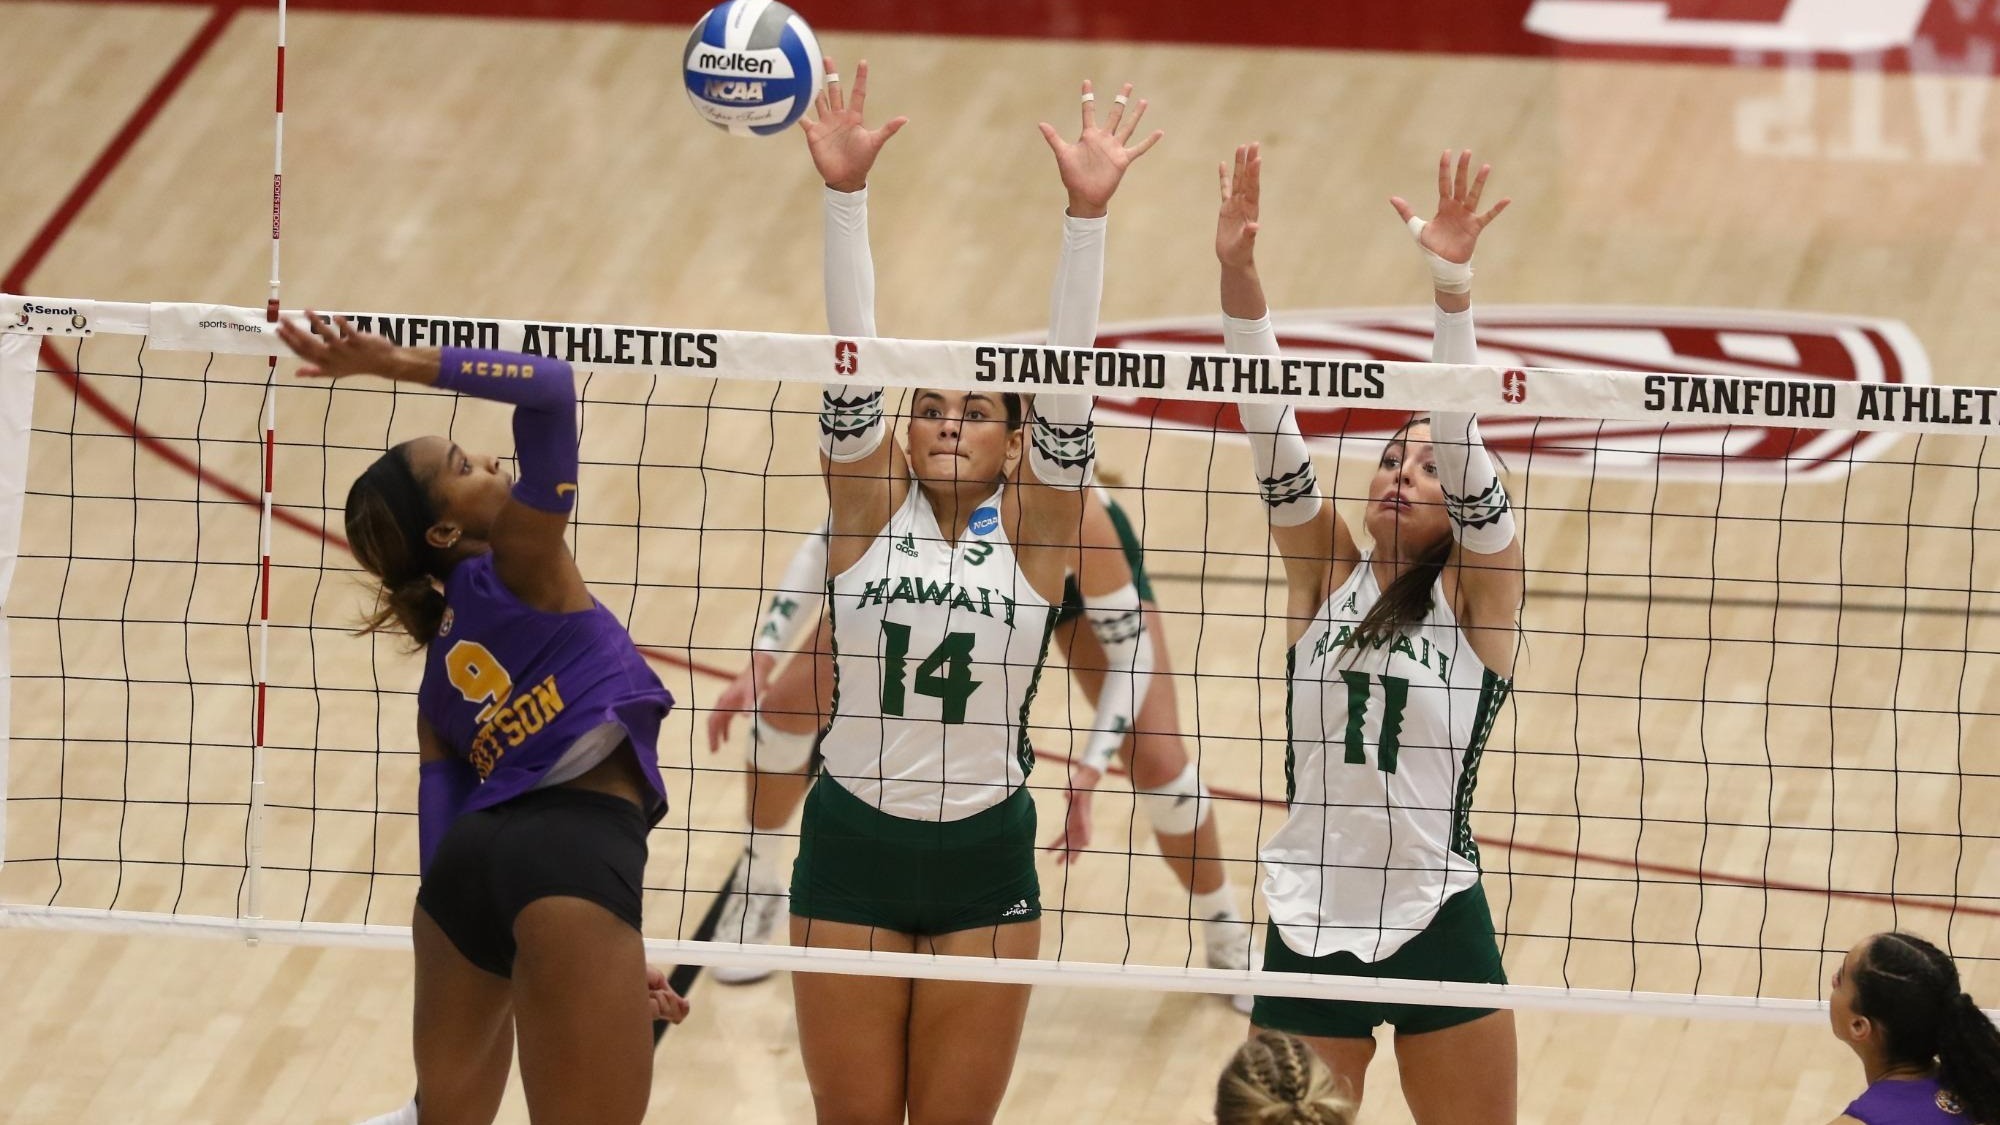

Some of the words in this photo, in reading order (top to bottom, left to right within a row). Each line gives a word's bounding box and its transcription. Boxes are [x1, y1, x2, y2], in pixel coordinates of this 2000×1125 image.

[699, 53, 772, 75] molten
[704, 79, 764, 102] NCAA
[35, 305, 77, 315] Senoh
[199, 321, 228, 329] sports
[228, 322, 262, 333] imports
[521, 324, 718, 369] ATHLETICS
[975, 346, 1165, 389] STANFORD
[1186, 356, 1385, 399] ATHLETICS
[1644, 375, 1836, 418] STANFORD
[1857, 384, 2000, 425] ATHLET
[856, 577, 1017, 630] HAWAI'I
[445, 639, 513, 724] 9
[880, 620, 983, 725] 14
[1339, 670, 1410, 775] 11
